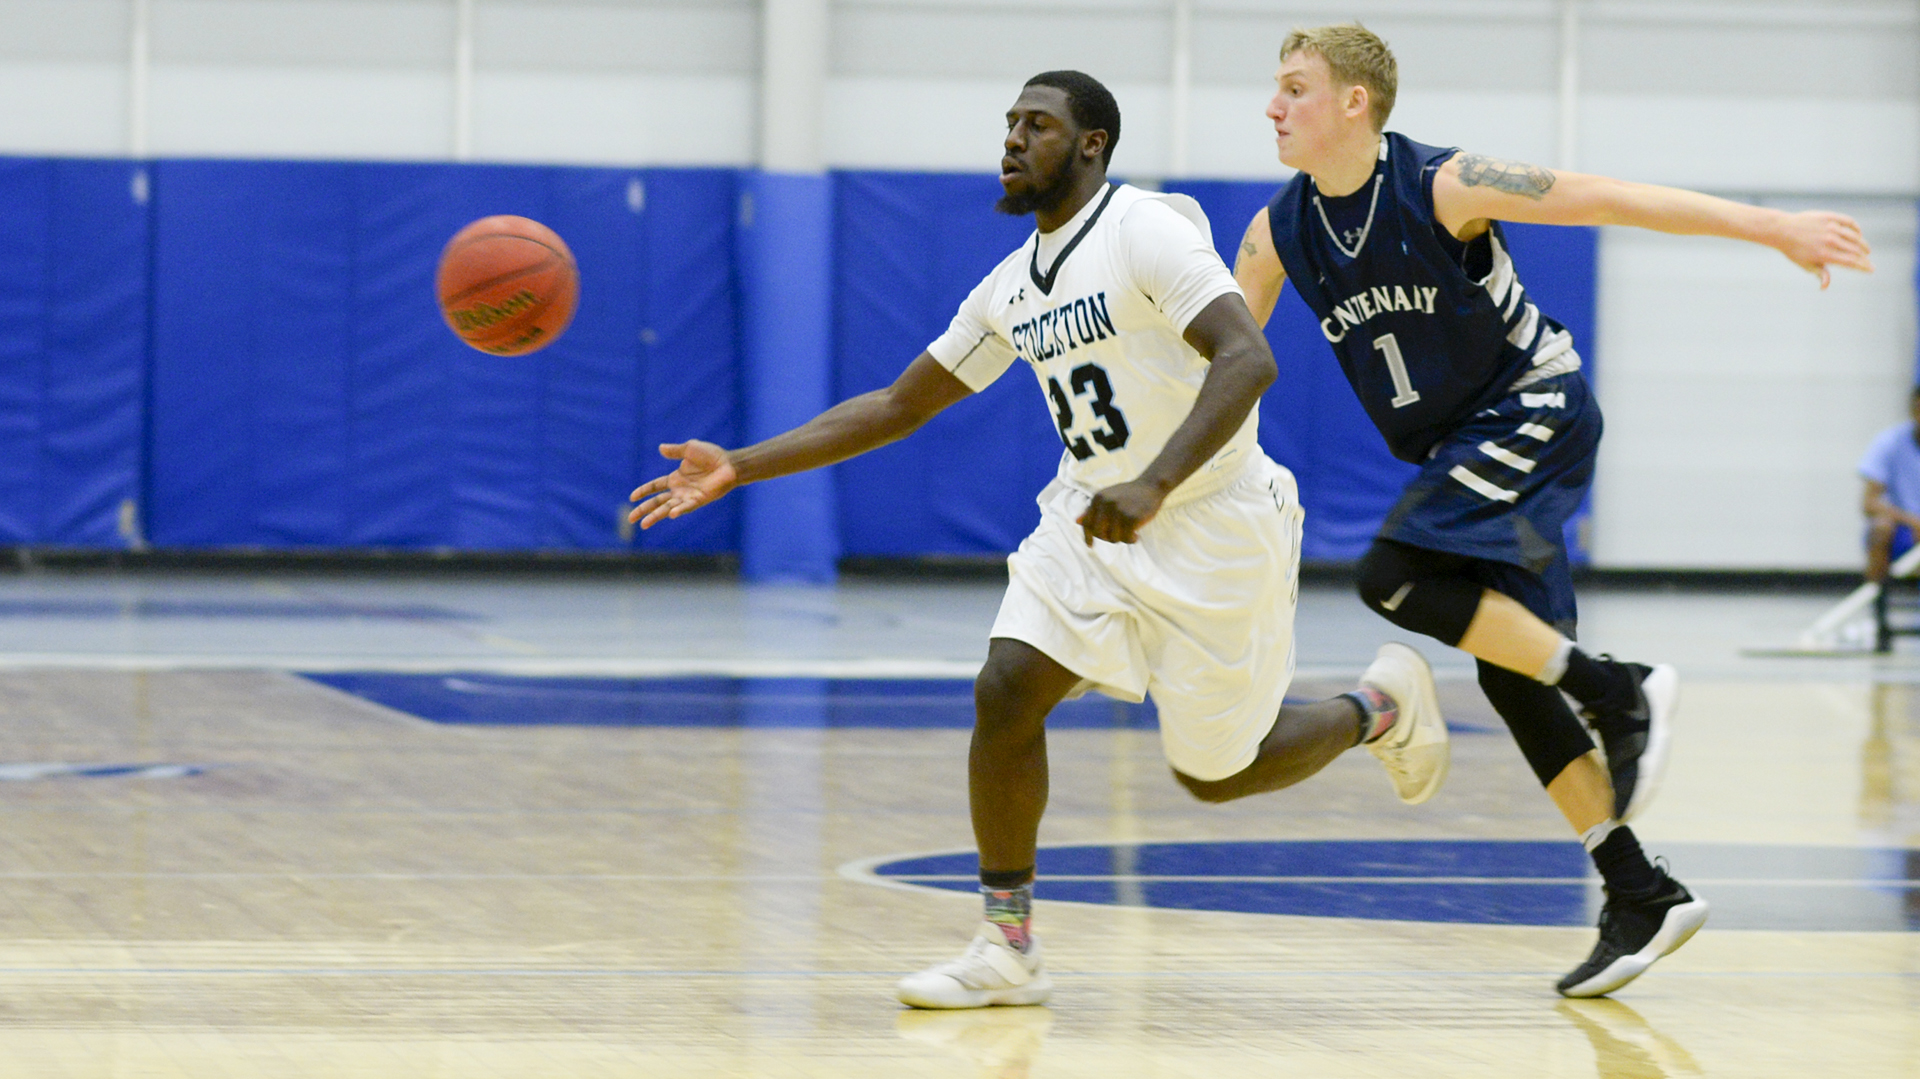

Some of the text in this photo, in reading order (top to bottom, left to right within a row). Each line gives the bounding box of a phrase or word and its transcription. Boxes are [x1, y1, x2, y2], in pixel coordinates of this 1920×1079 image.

[1321, 284, 1438, 343] CNTENAY
[1372, 332, 1421, 409] 1
[1047, 360, 1132, 462] 23
